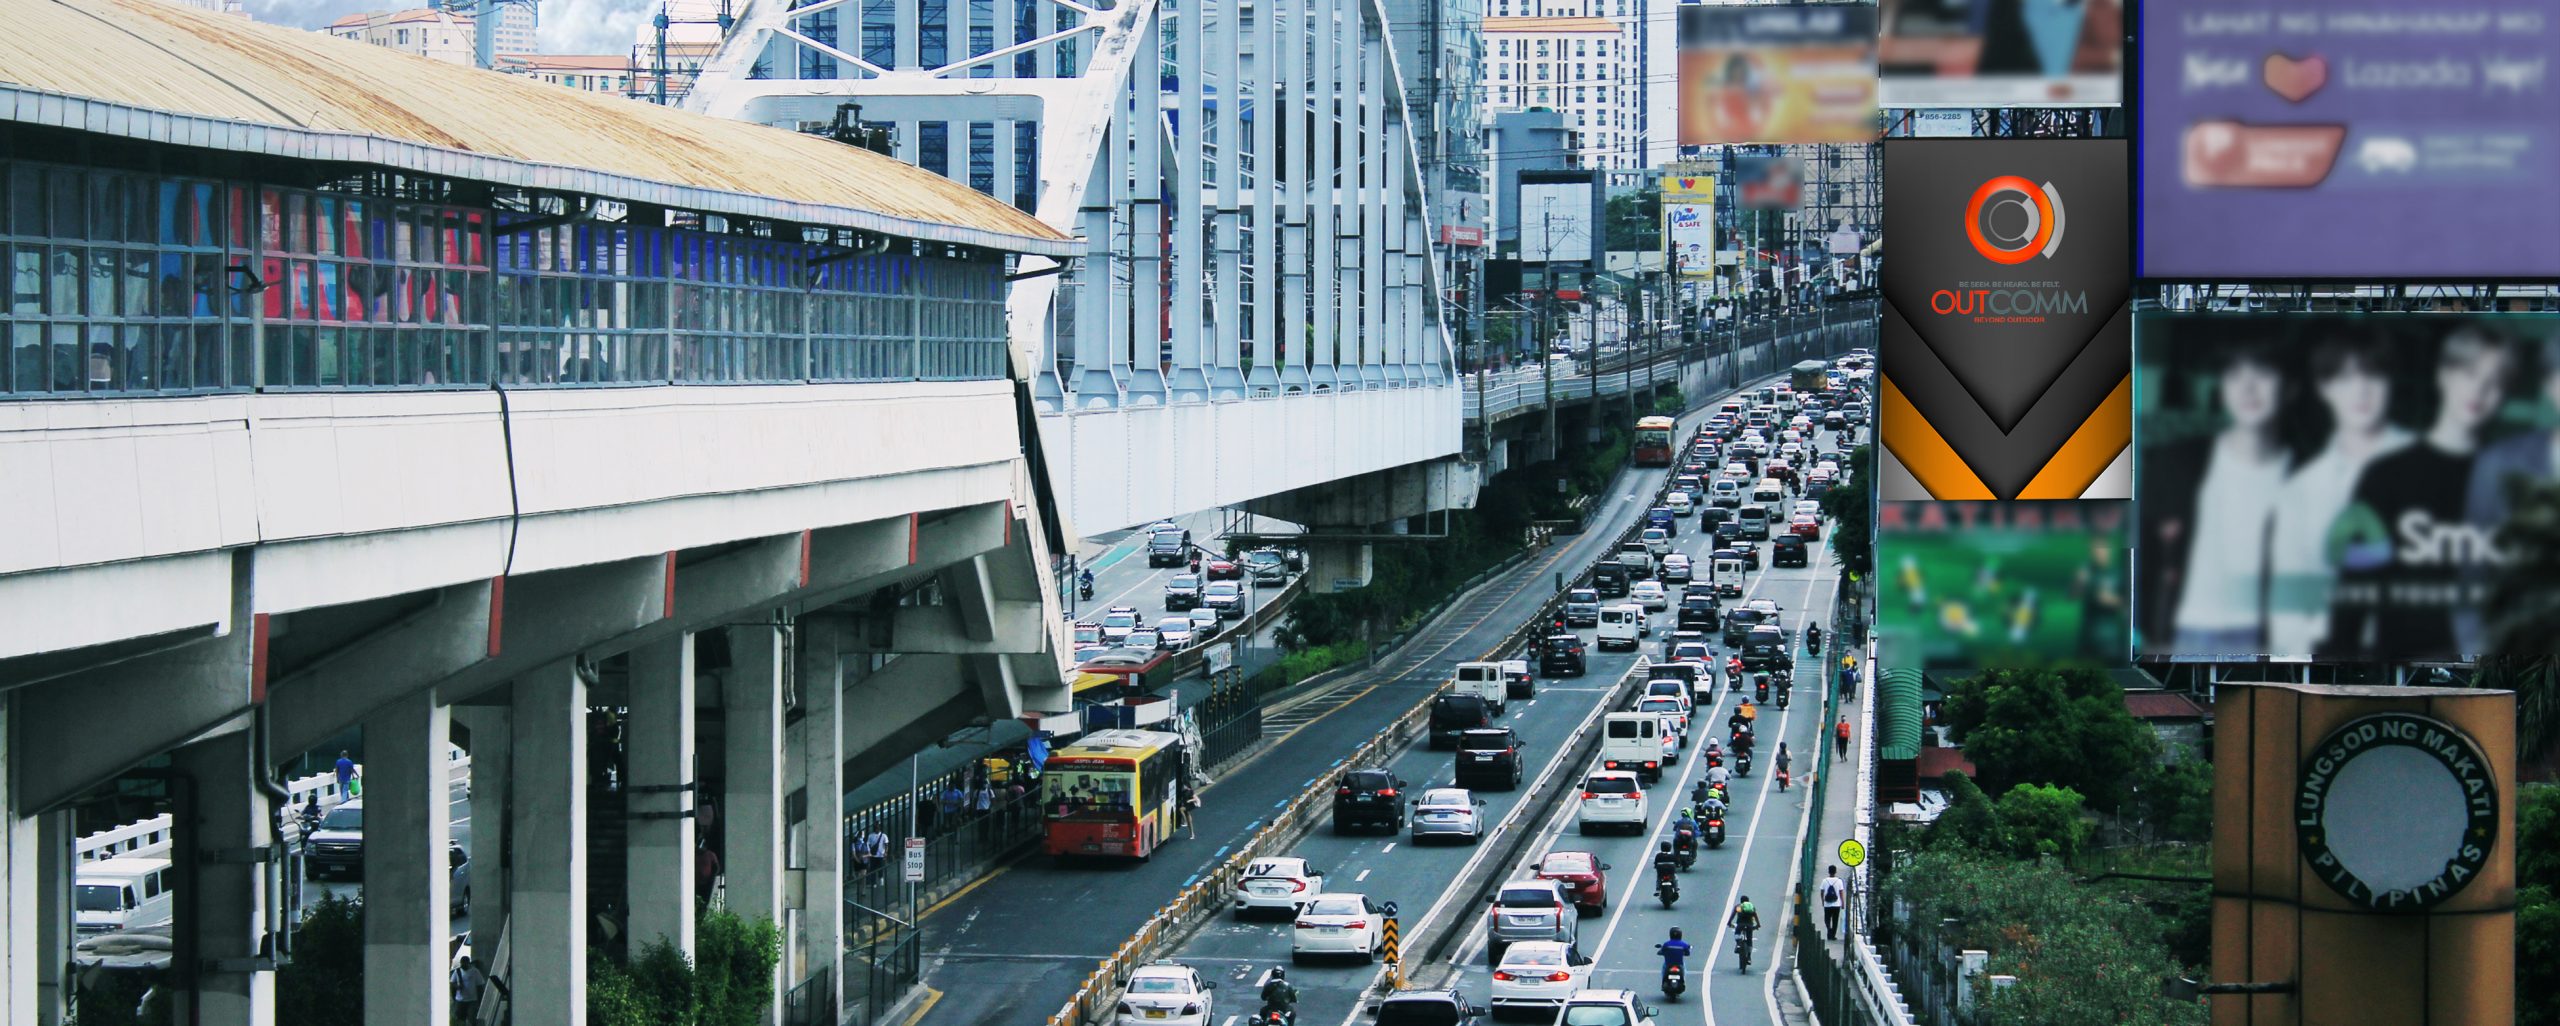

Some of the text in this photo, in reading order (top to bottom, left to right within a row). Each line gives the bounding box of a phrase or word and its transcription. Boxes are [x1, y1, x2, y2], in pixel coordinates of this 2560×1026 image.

[1931, 289, 2088, 315] OUTCOMM
[2300, 720, 2491, 826] LUNGSOD NG MAKATI
[907, 862, 923, 870] Stop
